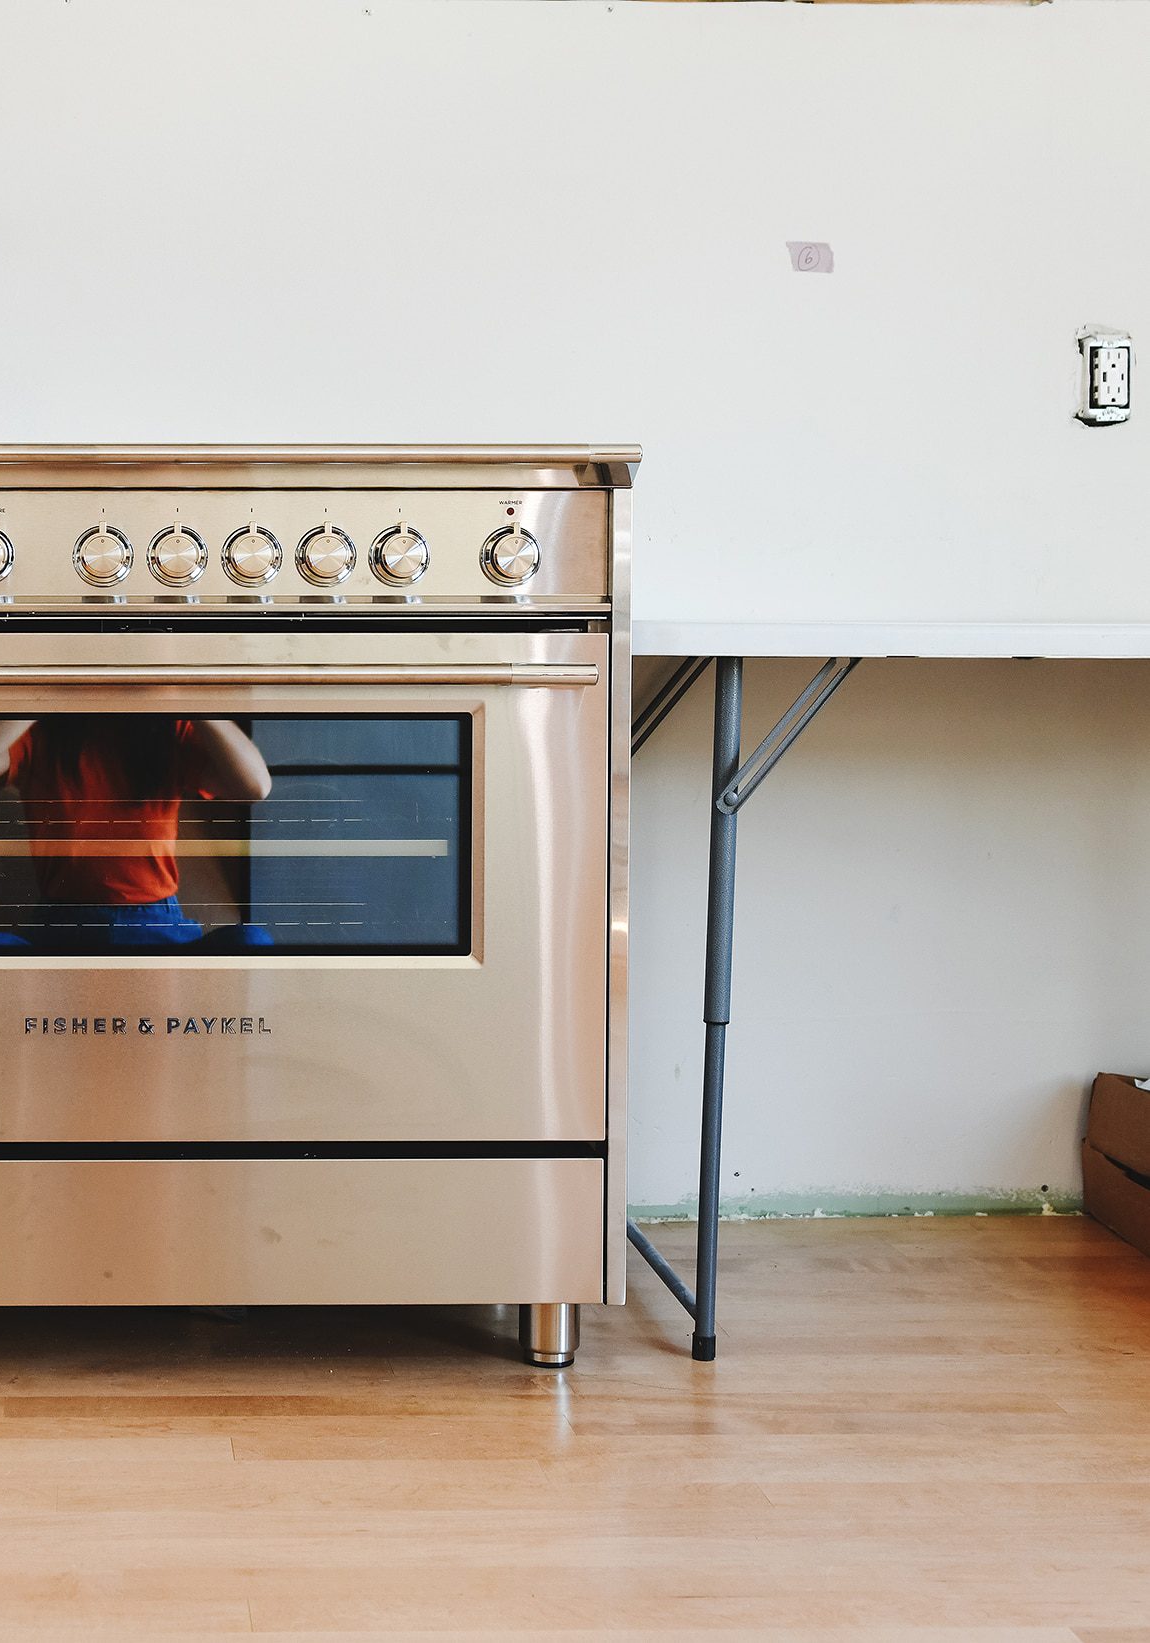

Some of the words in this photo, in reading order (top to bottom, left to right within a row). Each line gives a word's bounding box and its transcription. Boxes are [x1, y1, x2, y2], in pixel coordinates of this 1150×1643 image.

[25, 1017, 128, 1035] FISHER
[138, 1017, 156, 1035] &
[166, 1017, 272, 1035] PAYKEL
